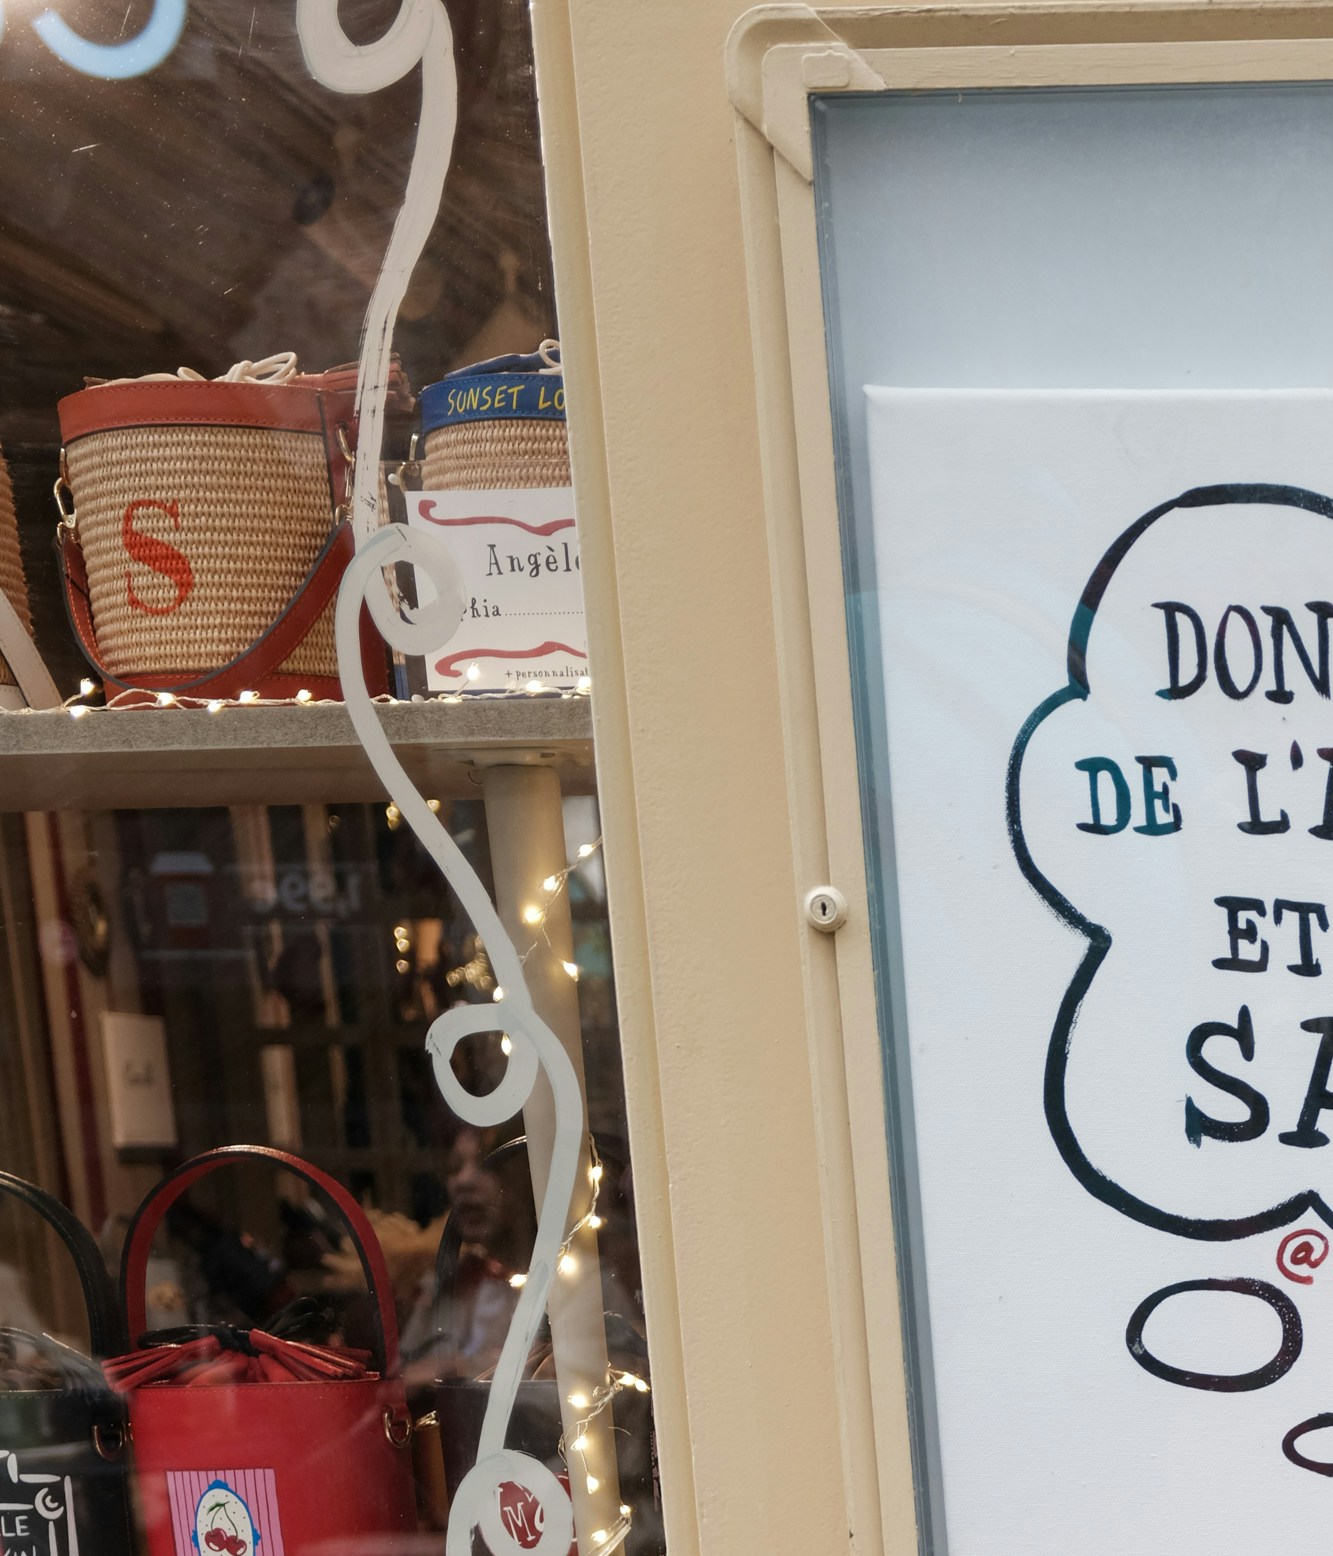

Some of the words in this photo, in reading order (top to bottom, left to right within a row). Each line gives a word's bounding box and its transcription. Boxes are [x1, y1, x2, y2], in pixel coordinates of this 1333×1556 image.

[447, 385, 525, 416] SUNSET
[122, 498, 194, 616] S
[1074, 755, 1183, 837] DE
[1211, 895, 1330, 978] ET
[0, 1515, 30, 1537] LE
